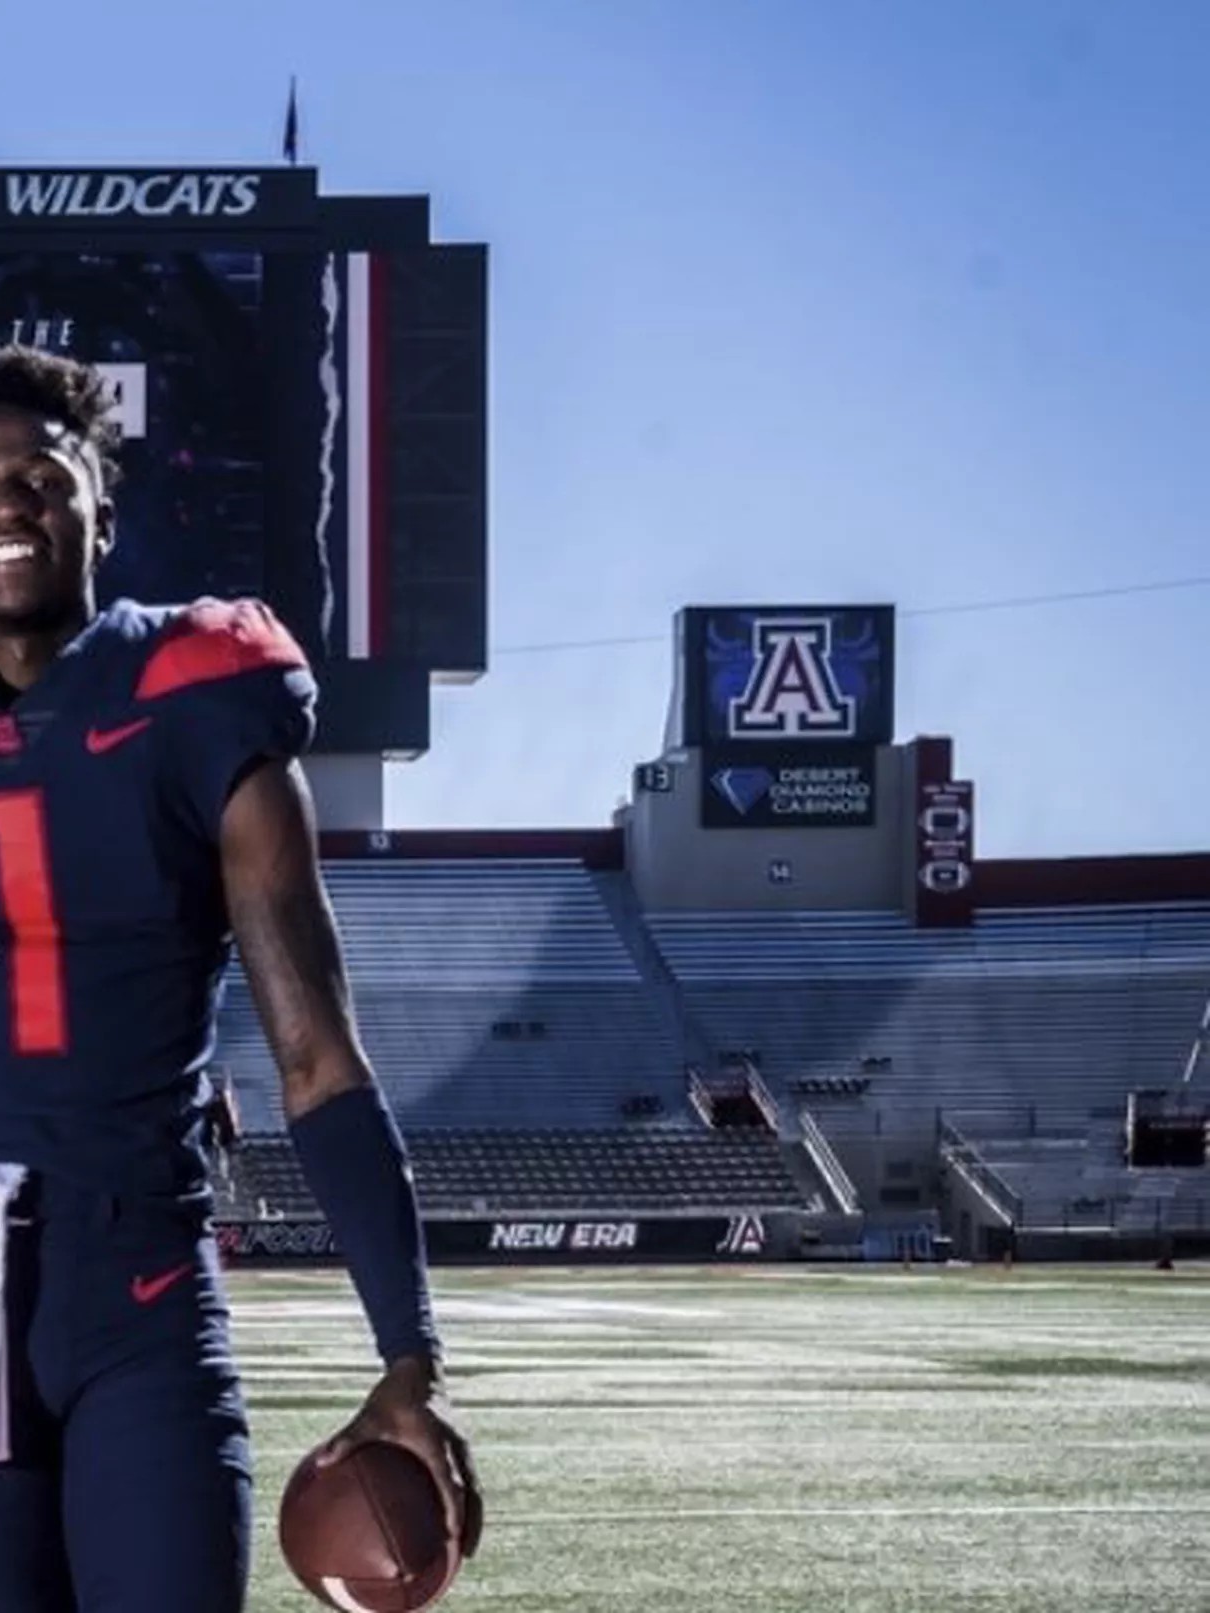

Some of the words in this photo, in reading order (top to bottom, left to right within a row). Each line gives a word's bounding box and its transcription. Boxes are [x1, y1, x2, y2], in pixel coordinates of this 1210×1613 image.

[5, 175, 260, 216] WILDCATS
[10, 319, 75, 346] THE
[729, 618, 855, 738] A
[769, 782, 871, 797] DIAMOND
[490, 1223, 565, 1248] NEW
[570, 1223, 637, 1248] ERA
